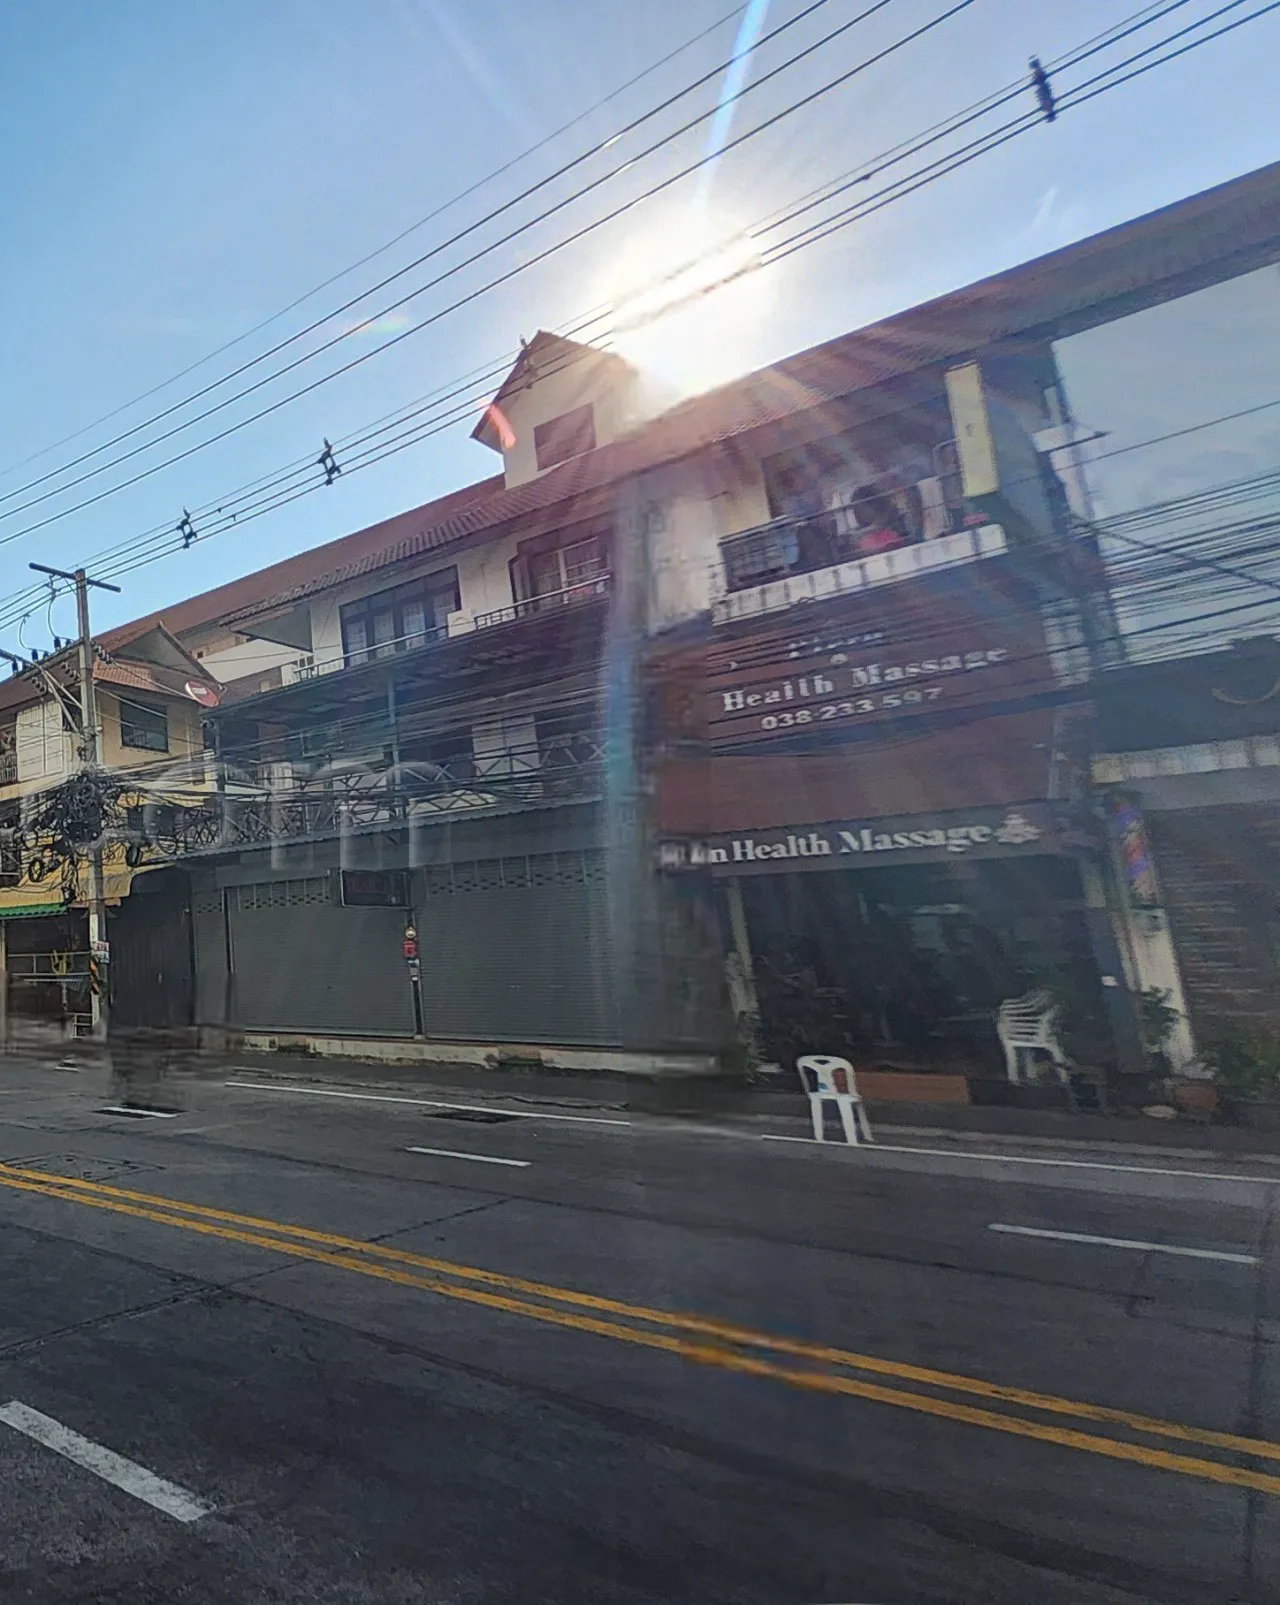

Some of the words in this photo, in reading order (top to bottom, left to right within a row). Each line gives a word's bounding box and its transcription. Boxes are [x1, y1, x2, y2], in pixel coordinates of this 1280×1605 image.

[851, 648, 1009, 688] Massage
[733, 832, 832, 863] Health
[838, 824, 991, 853] Massage
